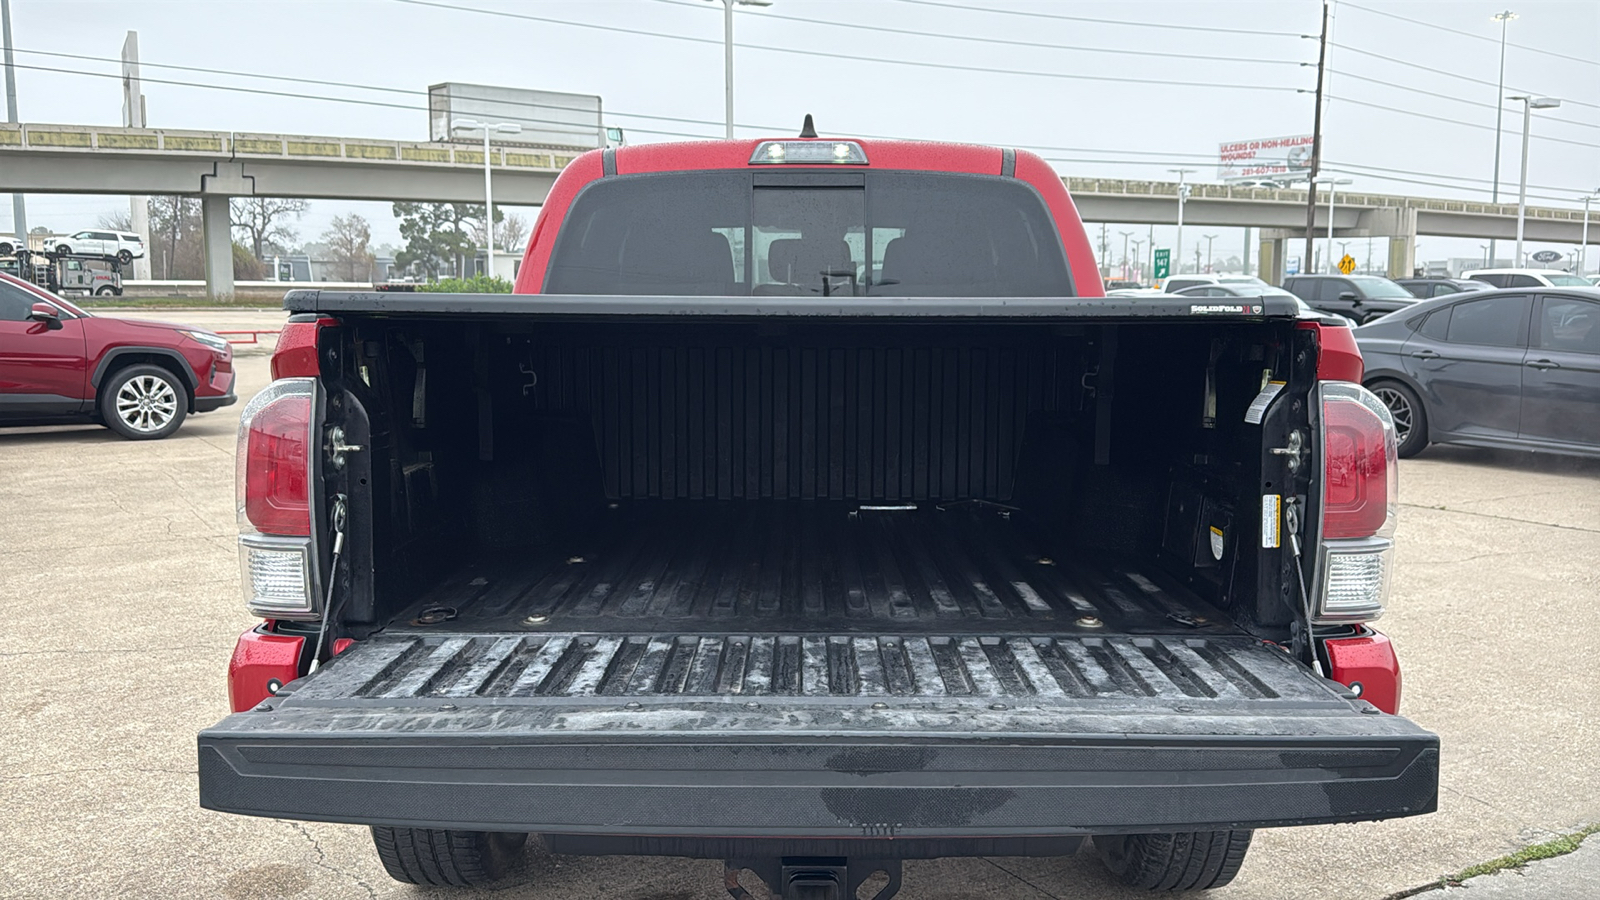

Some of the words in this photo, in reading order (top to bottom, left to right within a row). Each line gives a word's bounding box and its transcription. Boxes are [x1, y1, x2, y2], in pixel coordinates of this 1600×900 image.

[1221, 143, 1248, 153] ULCERS
[1261, 137, 1314, 149] NON-HEALING
[1221, 151, 1257, 161] WOUNDS?
[1157, 258, 1168, 267] 147
